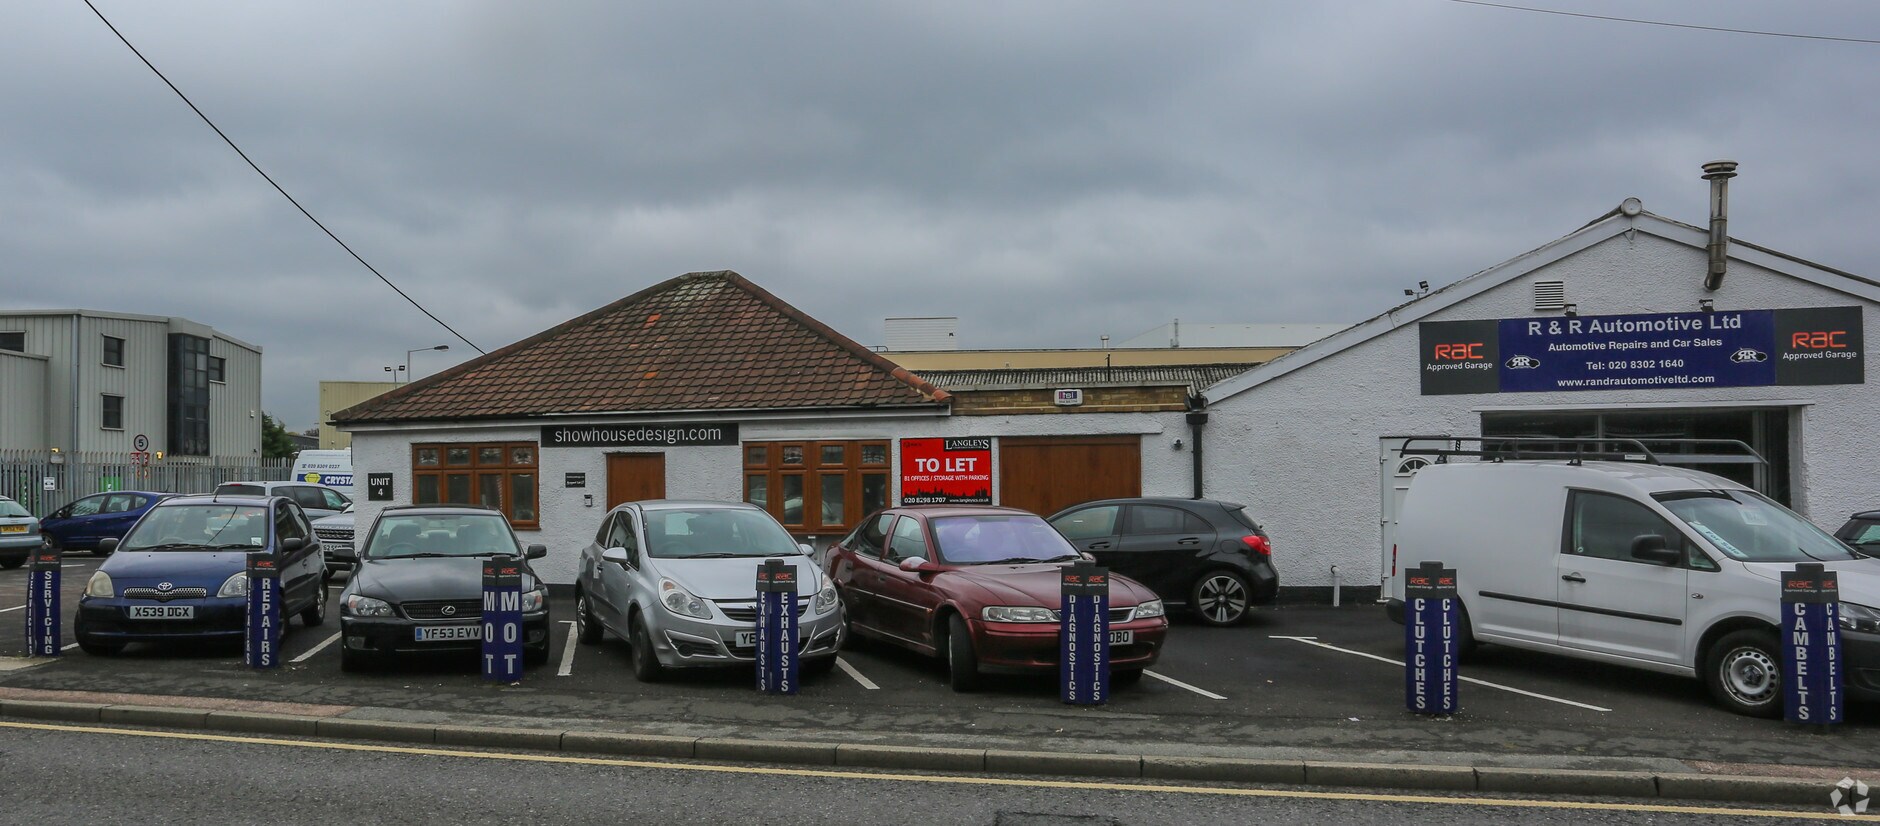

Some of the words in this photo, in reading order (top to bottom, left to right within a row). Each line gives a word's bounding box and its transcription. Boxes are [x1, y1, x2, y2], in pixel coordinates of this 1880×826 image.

[1528, 321, 1542, 335] R
[1548, 320, 1562, 334] &
[1569, 320, 1582, 334] R
[1589, 317, 1703, 333] Automotive
[1710, 314, 1741, 329] Ltd
[1548, 342, 1606, 351] Automotive
[1608, 340, 1648, 351] Repairs
[1650, 339, 1670, 348] and
[1672, 338, 1691, 347] Car
[1693, 338, 1722, 346] Sales
[1782, 351, 1823, 361] Approved
[1825, 350, 1857, 359] Garage
[1426, 362, 1463, 371] Approved
[1464, 361, 1493, 370] Garage
[1586, 361, 1605, 370] Tel:
[1608, 361, 1627, 369] 020
[1630, 360, 1655, 369] 8302
[1658, 359, 1684, 368] 1640
[1557, 375, 1715, 387] www.randrautomotiveltd.com
[555, 426, 721, 444] showhousedesign.com
[138, 439, 144, 447] 5
[945, 439, 989, 449] LANGLEYS
[915, 458, 940, 472] TO
[945, 458, 977, 472] LET
[371, 478, 390, 486] UNIT
[377, 488, 384, 496] 4
[44, 571, 52, 654] SERVICING
[135, 607, 164, 617] X539
[167, 607, 190, 617] DGX
[261, 578, 271, 665] REPAIRS
[424, 628, 454, 638] YF53
[457, 627, 480, 638] EVV
[483, 591, 495, 674] MOT
[500, 591, 519, 674] MOT
[781, 592, 789, 692] EXHAUSTS
[1415, 598, 1425, 709] CLUTCHES
[1442, 598, 1451, 709] CLUTCHES
[1793, 602, 1809, 720] CAMBELTS
[1826, 602, 1836, 720] CAMBELTS
